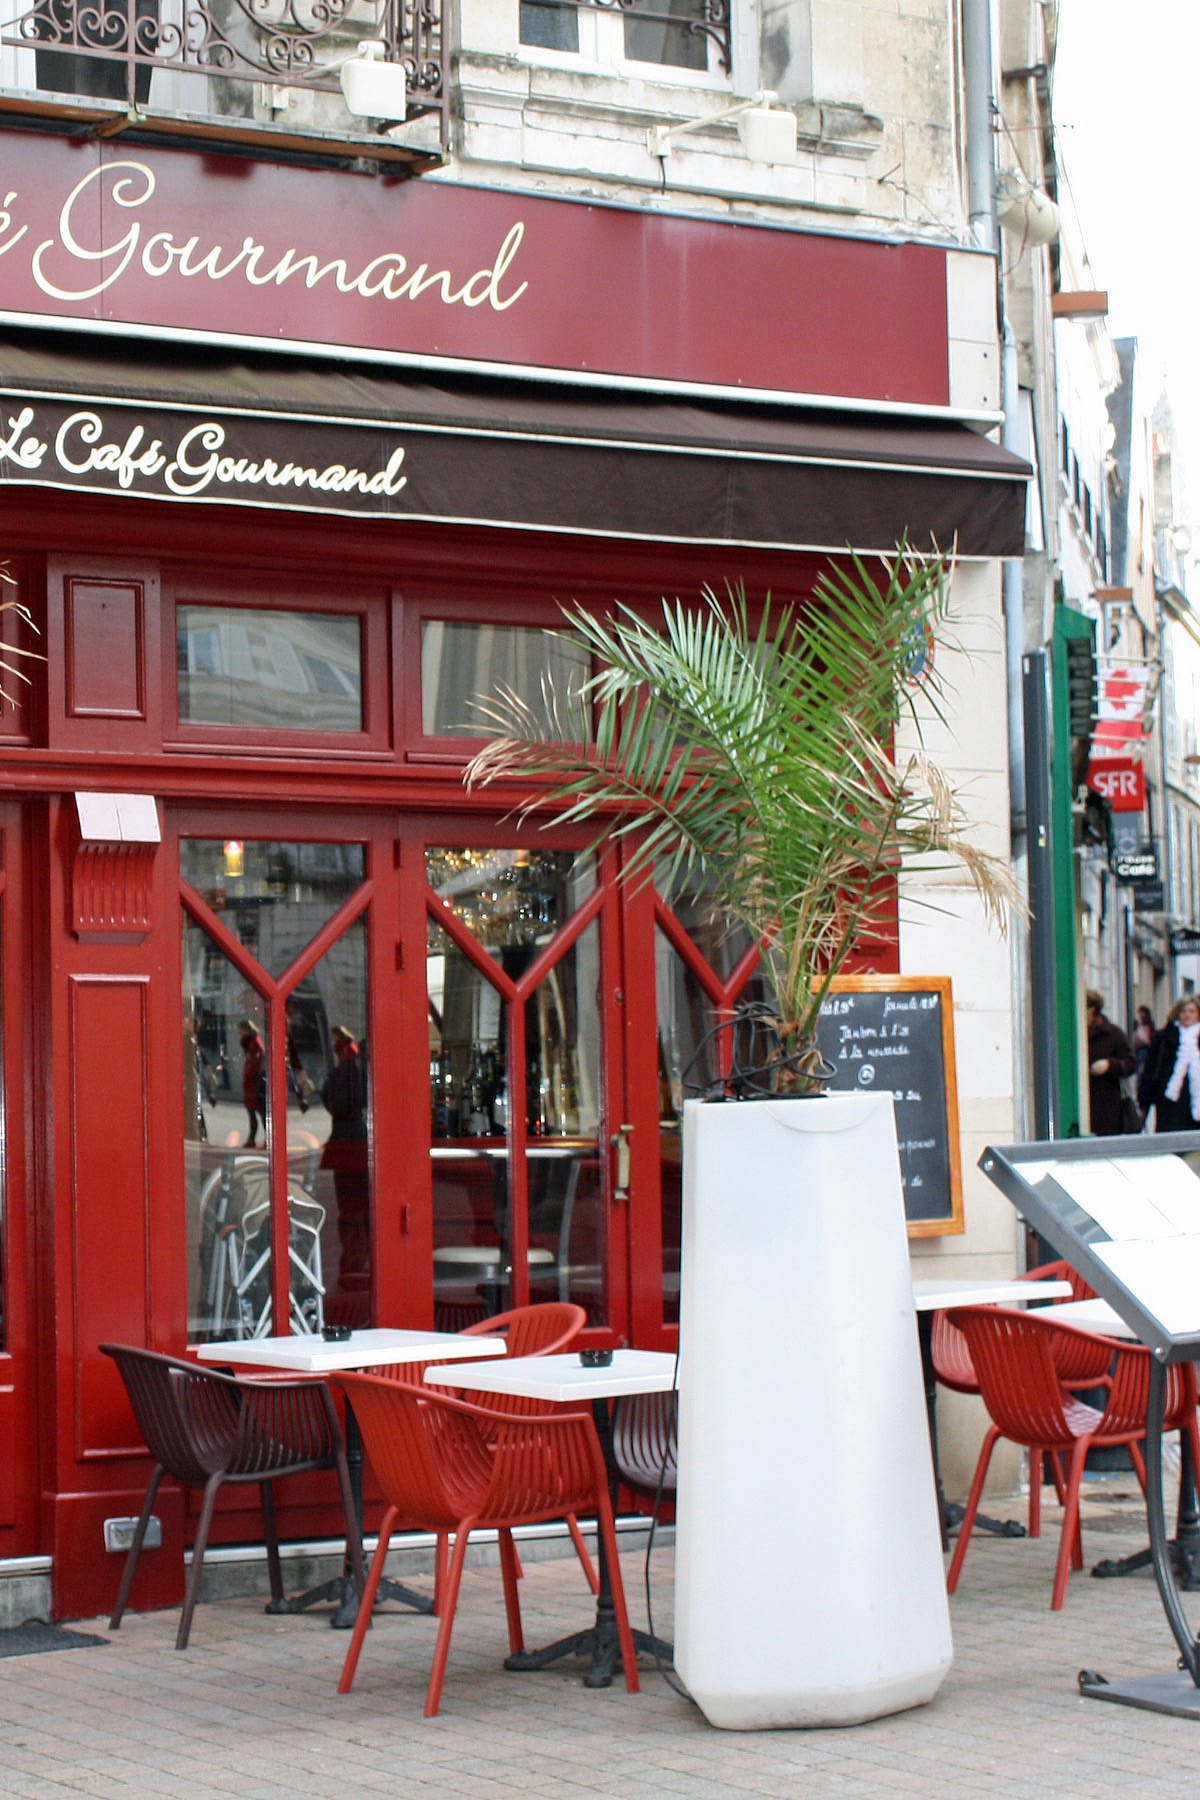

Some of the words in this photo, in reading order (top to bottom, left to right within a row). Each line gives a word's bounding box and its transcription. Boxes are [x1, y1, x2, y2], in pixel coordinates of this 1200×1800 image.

[32, 160, 528, 311] Gourmand
[55, 411, 166, 489] Café
[164, 422, 407, 496] Gourmand
[1093, 770, 1137, 798] SFR
